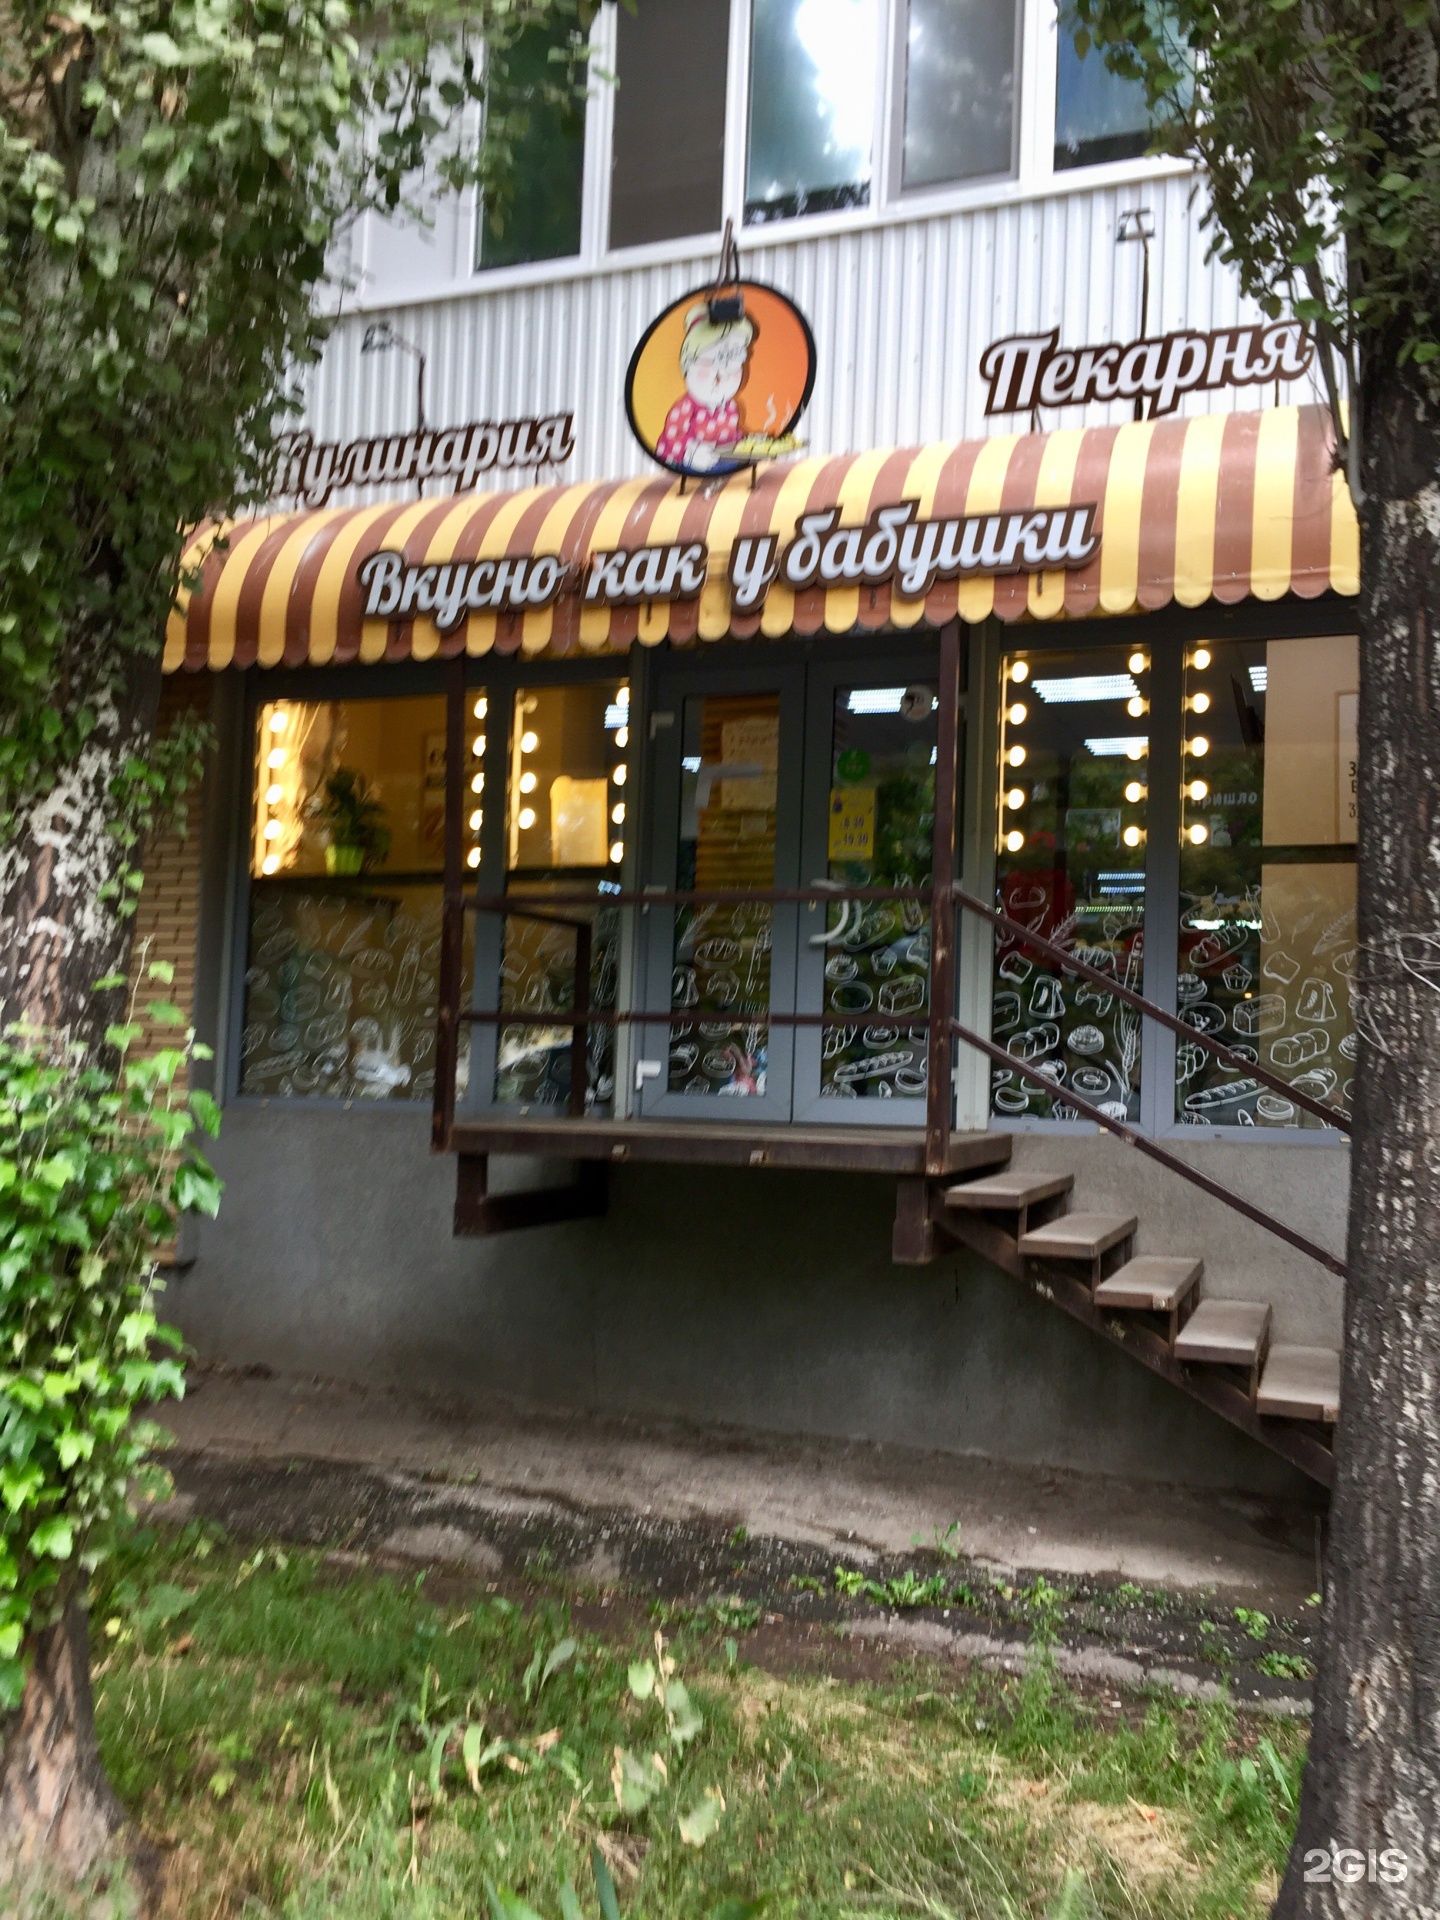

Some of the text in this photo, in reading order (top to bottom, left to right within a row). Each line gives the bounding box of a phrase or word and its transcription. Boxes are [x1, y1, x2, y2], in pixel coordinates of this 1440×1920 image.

[984, 324, 1312, 413] Пекарня
[268, 415, 572, 506] Кулинария
[362, 504, 1096, 628] Вкусно как у бабушки
